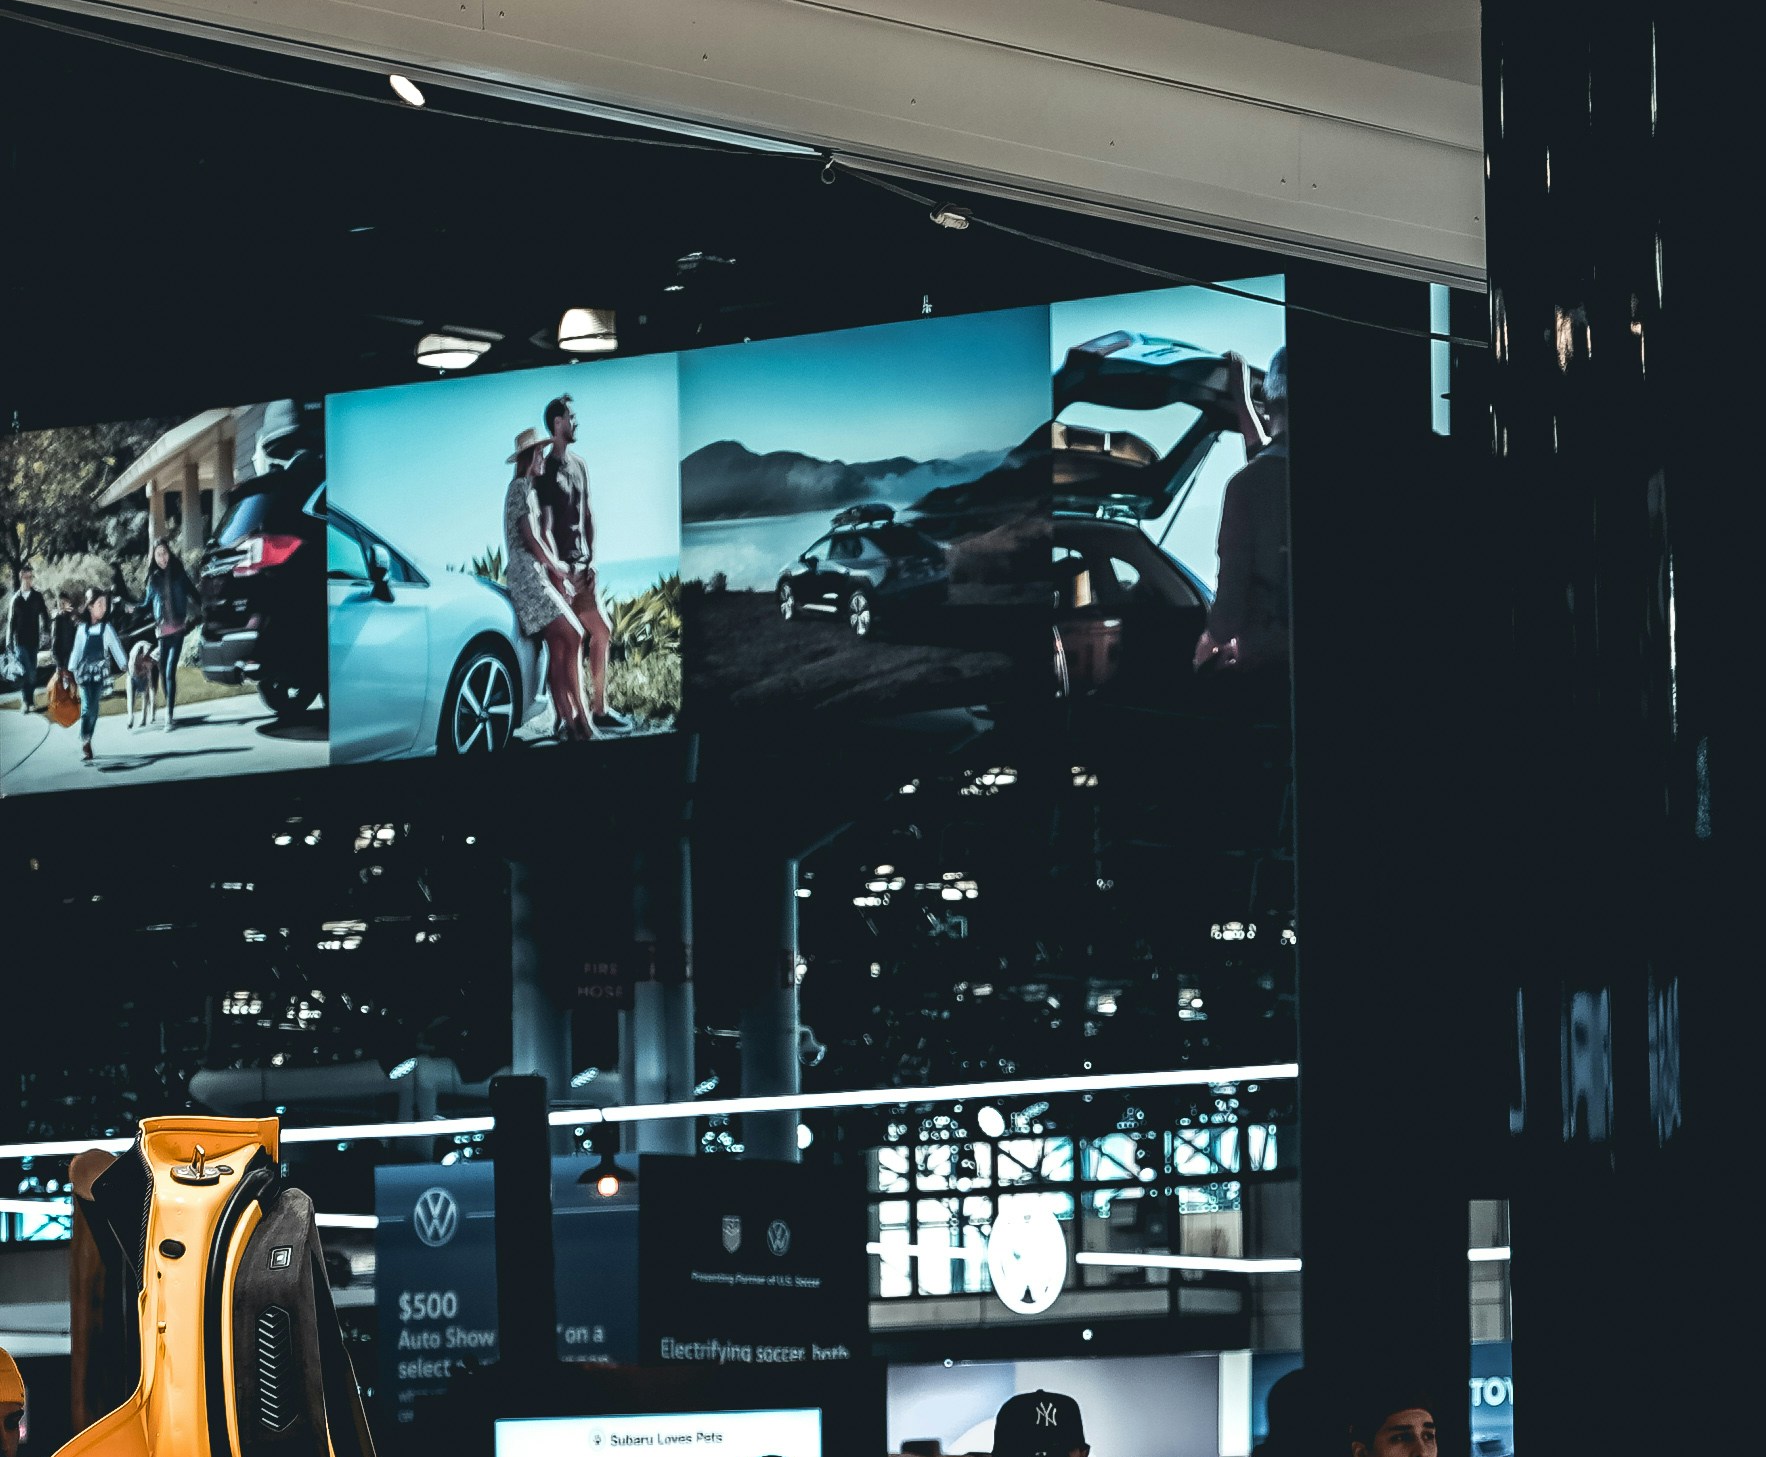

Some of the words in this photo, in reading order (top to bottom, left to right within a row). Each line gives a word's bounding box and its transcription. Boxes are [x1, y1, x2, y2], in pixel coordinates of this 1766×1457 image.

[398, 1290, 458, 1323] $500
[398, 1327, 441, 1350] Auto
[445, 1325, 495, 1349] Show
[660, 1336, 752, 1366] Electrifying
[398, 1357, 451, 1380] select
[1036, 1402, 1058, 1427] NY
[610, 1433, 654, 1447] Subaru
[657, 1432, 693, 1446] Loves
[696, 1431, 724, 1444] Pets
